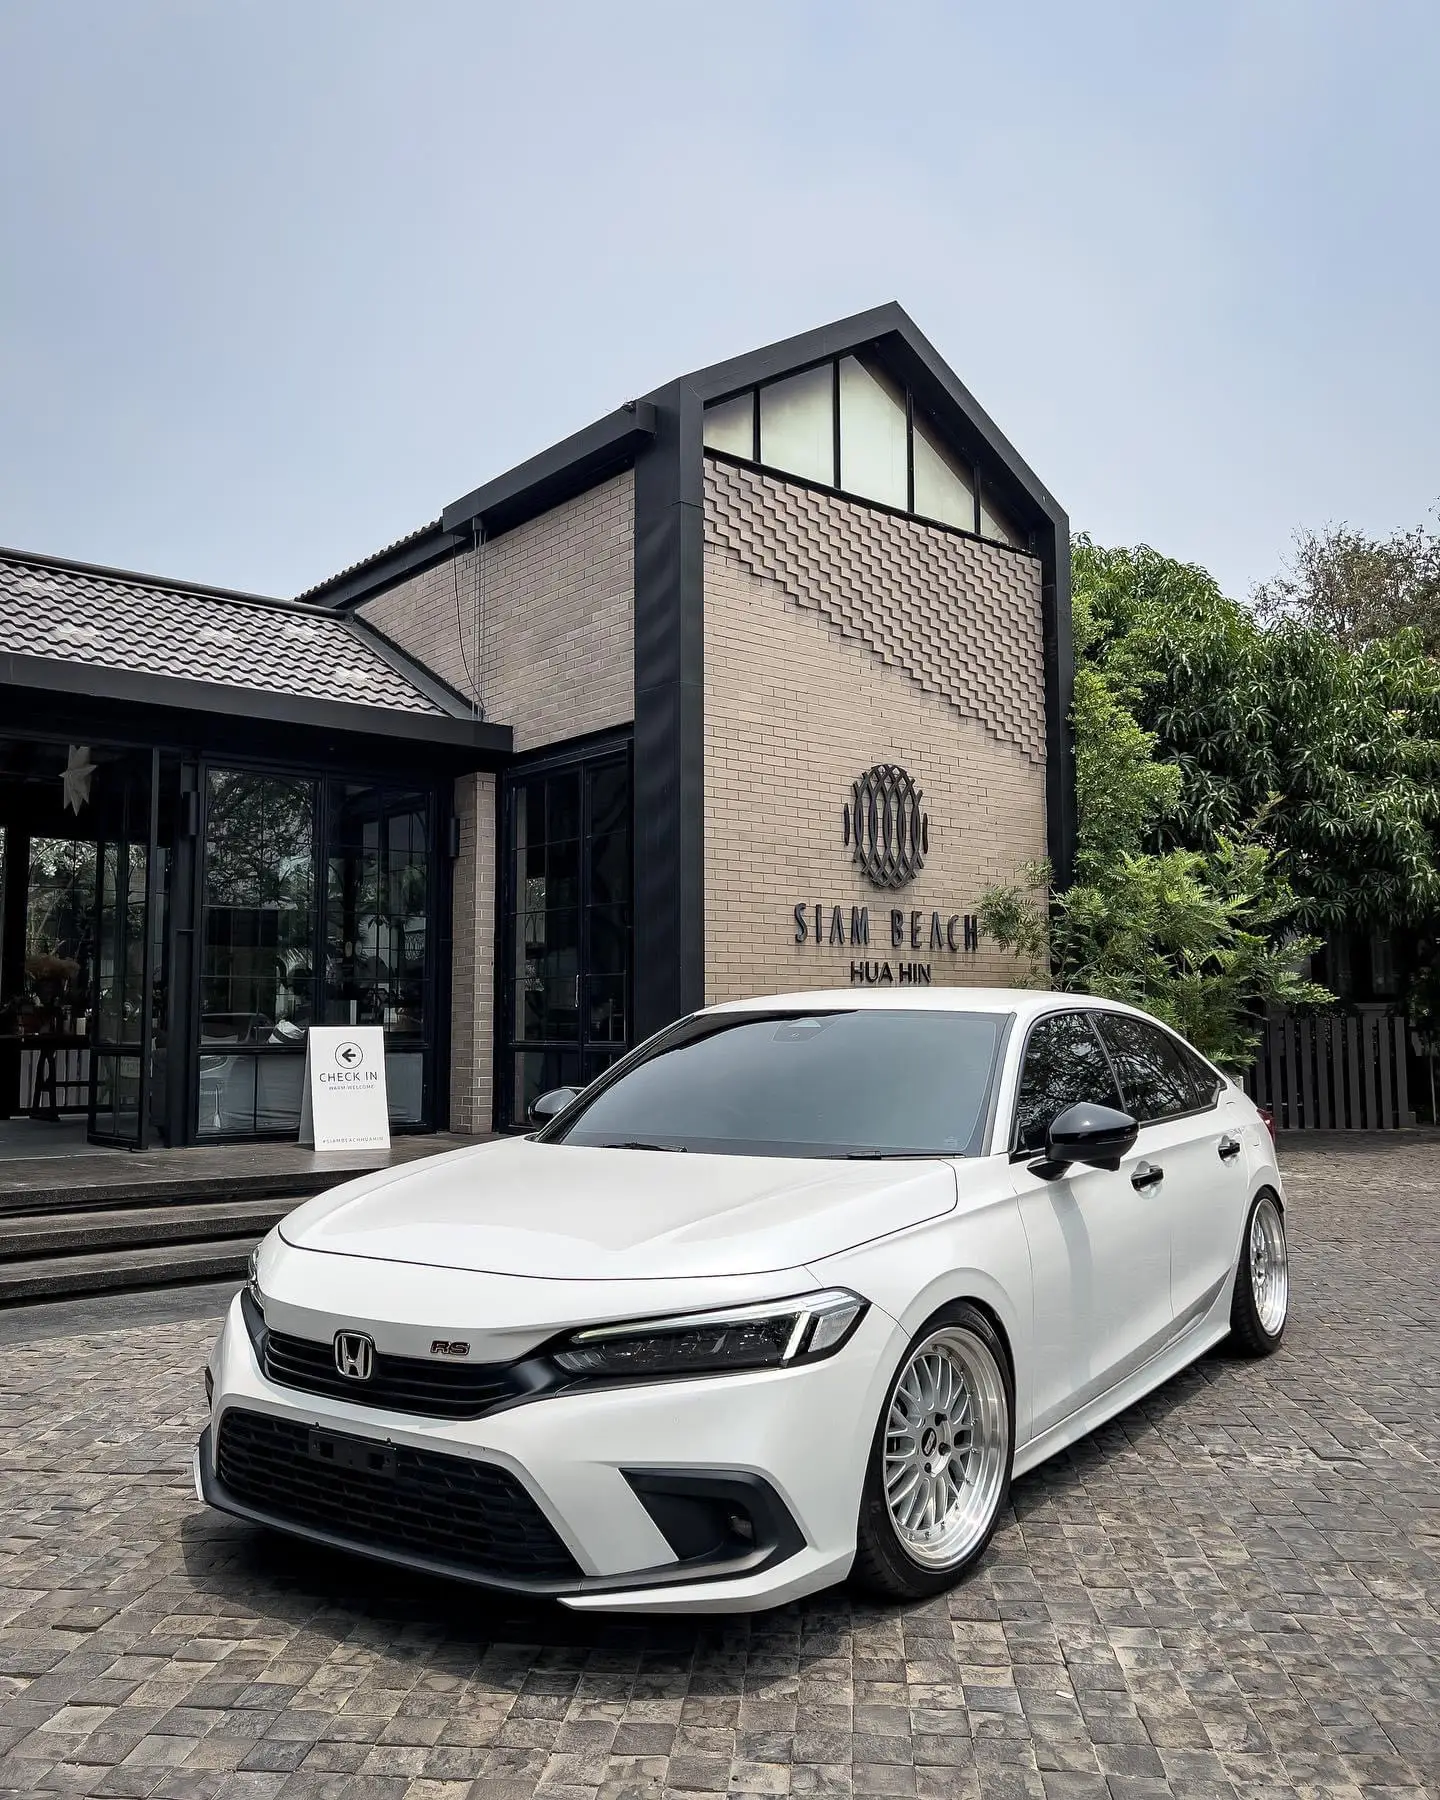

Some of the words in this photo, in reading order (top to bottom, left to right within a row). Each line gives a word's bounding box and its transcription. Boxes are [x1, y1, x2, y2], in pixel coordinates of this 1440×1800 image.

[794, 902, 870, 945] SIAM
[890, 908, 978, 951] BEACH
[850, 960, 894, 983] HUA
[899, 962, 932, 984] HIN
[319, 1072, 361, 1082] CHECK
[365, 1071, 378, 1080] IN
[430, 1340, 471, 1356] RS
